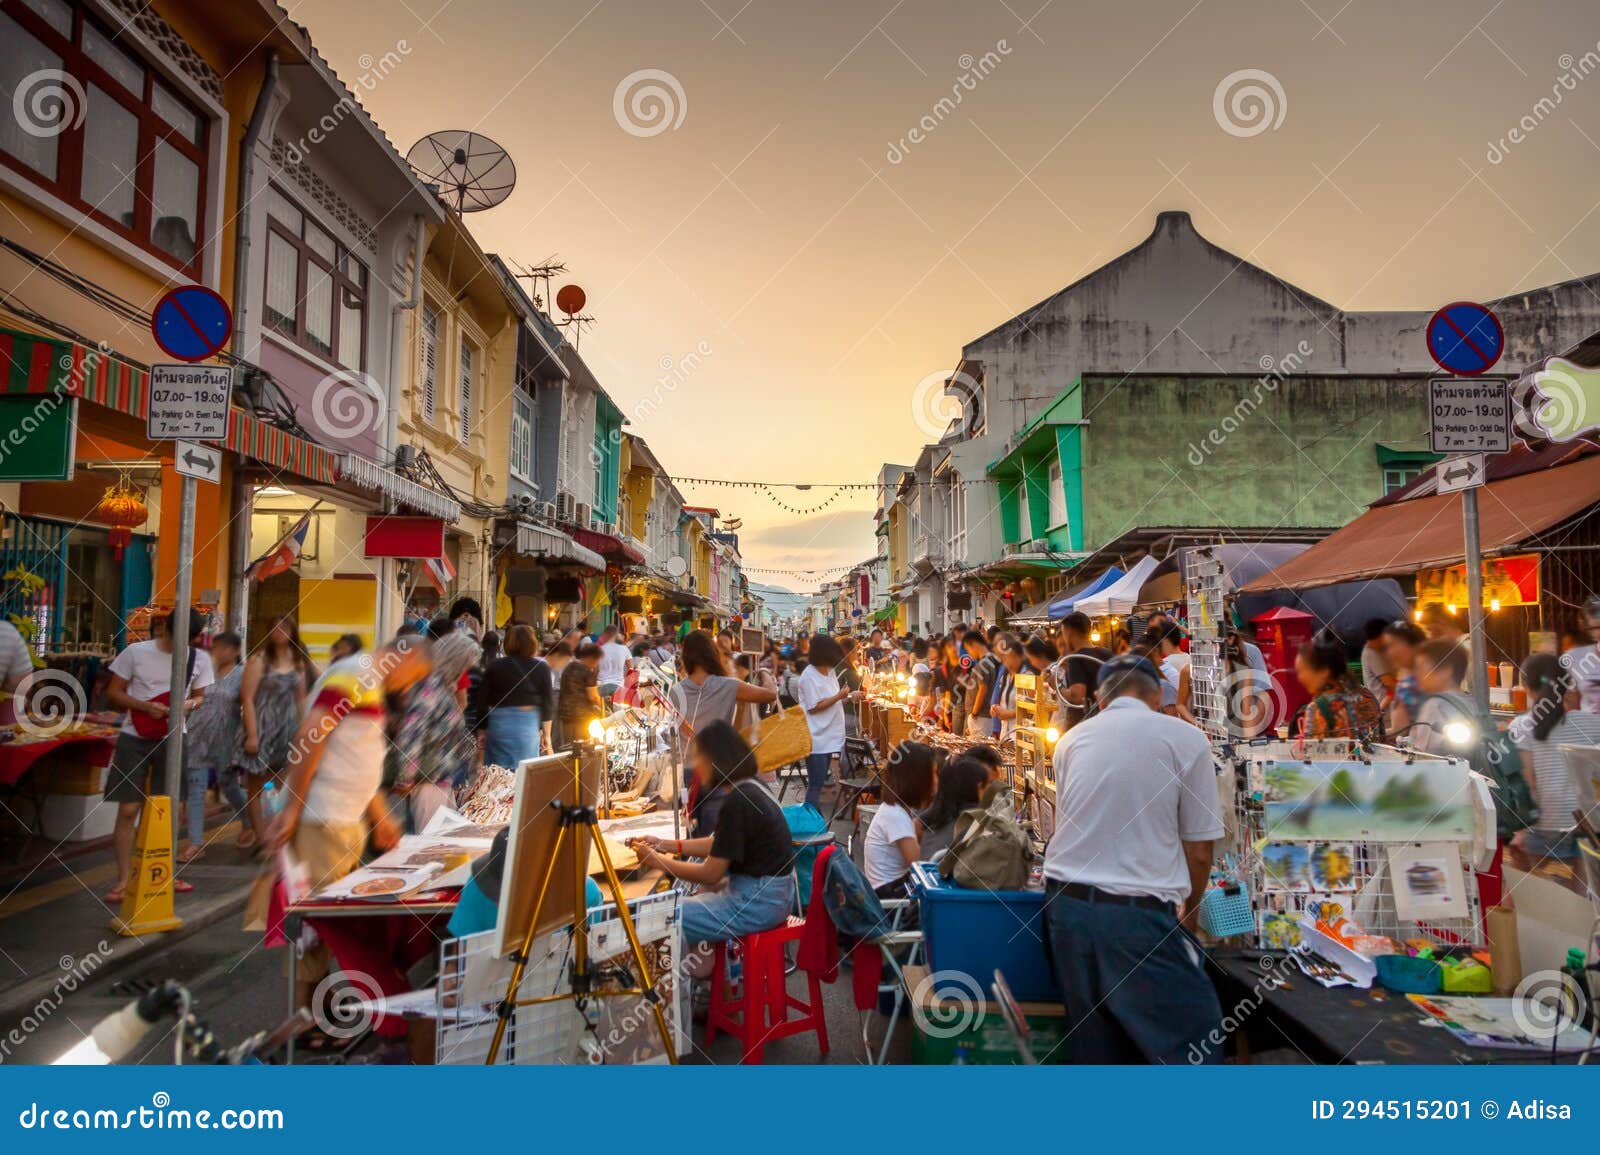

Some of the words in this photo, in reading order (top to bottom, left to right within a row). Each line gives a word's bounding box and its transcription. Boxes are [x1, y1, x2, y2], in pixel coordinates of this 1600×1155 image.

[162, 410, 183, 420] Parking
[185, 410, 194, 418] On
[196, 411, 211, 419] Even
[212, 410, 224, 420] Day
[160, 422, 167, 432] 7
[194, 422, 201, 432] 7
[1445, 424, 1468, 433] Parking
[1469, 424, 1478, 432] On
[1480, 424, 1492, 432] Odd
[1494, 424, 1505, 433] Day
[1443, 436, 1450, 446] 7
[1478, 436, 1485, 446] 7
[1486, 439, 1498, 447] pm
